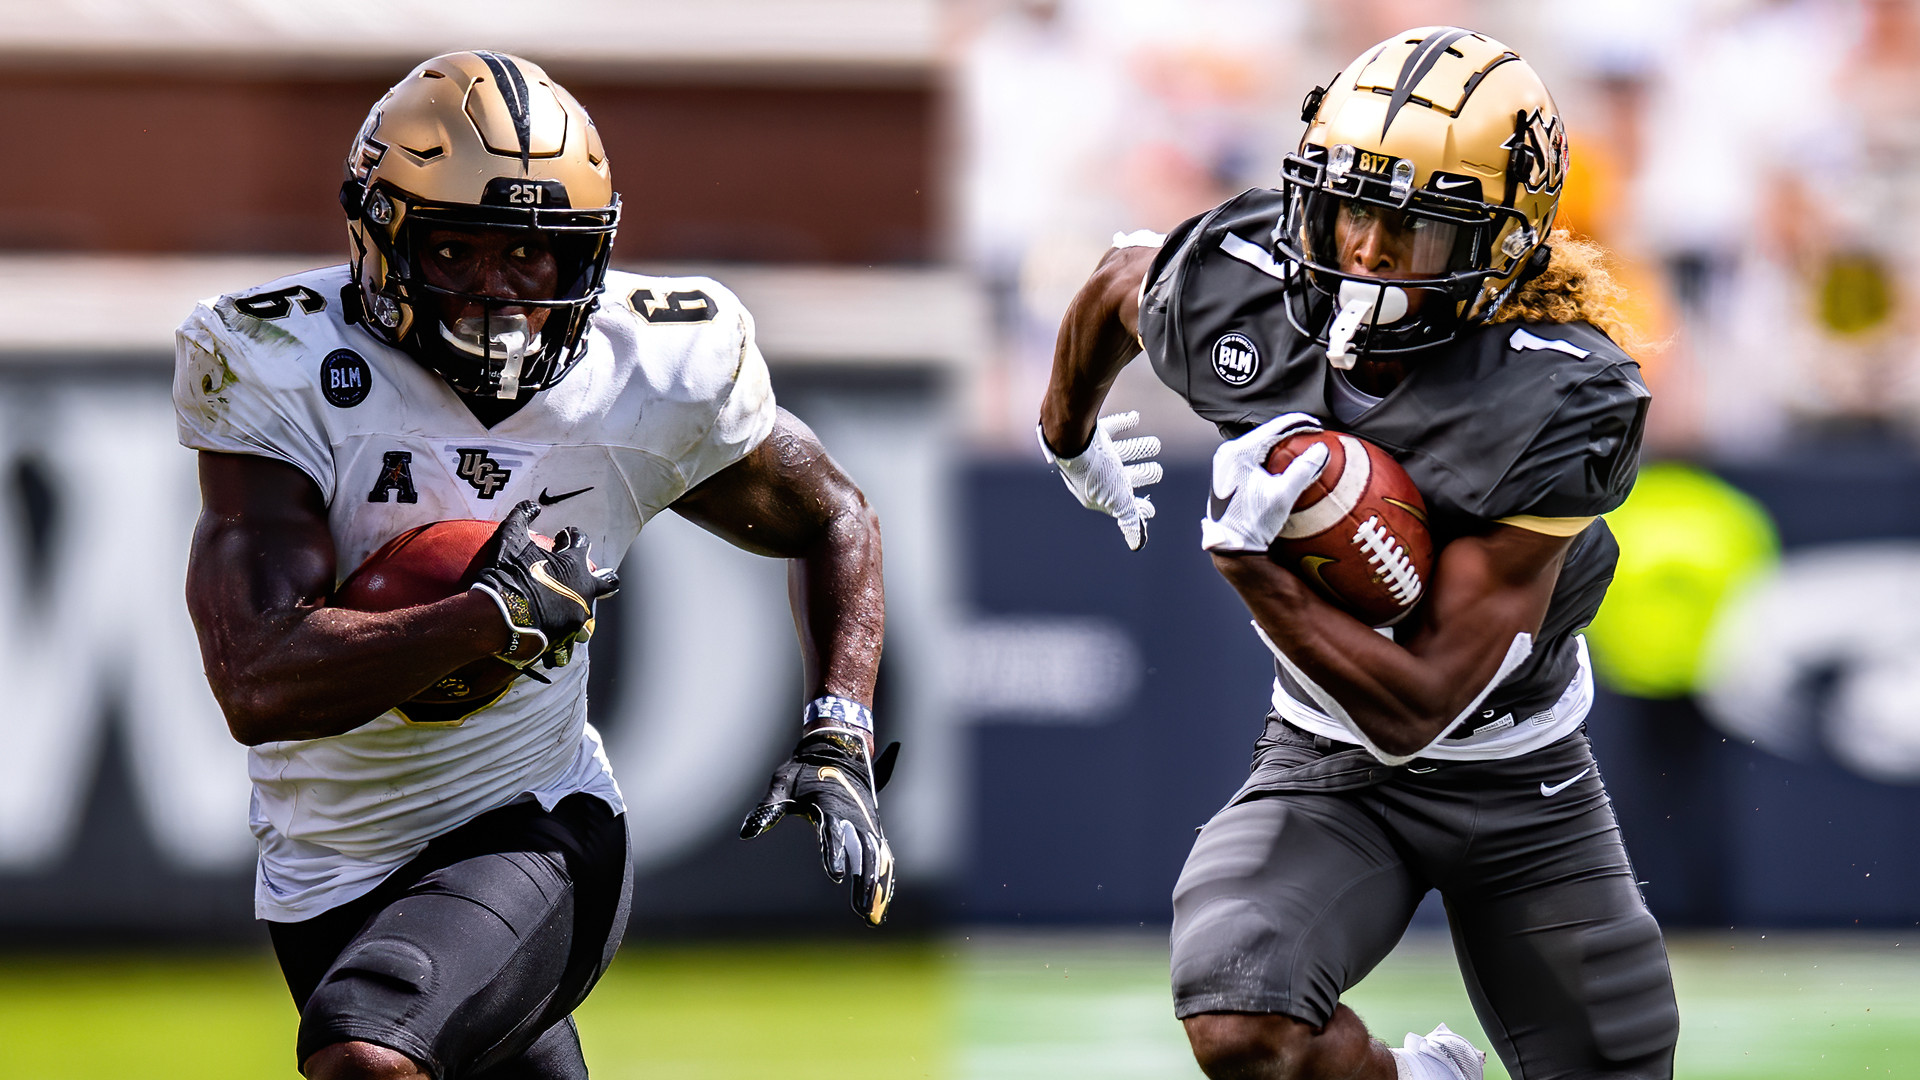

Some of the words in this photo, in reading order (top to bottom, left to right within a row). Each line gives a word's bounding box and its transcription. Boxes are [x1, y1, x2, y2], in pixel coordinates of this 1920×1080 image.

[1359, 152, 1390, 174] 817
[509, 184, 543, 205] 251
[232, 284, 328, 322] 6
[626, 287, 719, 326] 6
[1218, 345, 1253, 374] BLM
[1509, 327, 1592, 360] 1
[330, 366, 362, 389] BLM
[367, 450, 419, 504] A
[458, 450, 509, 498] UCF
